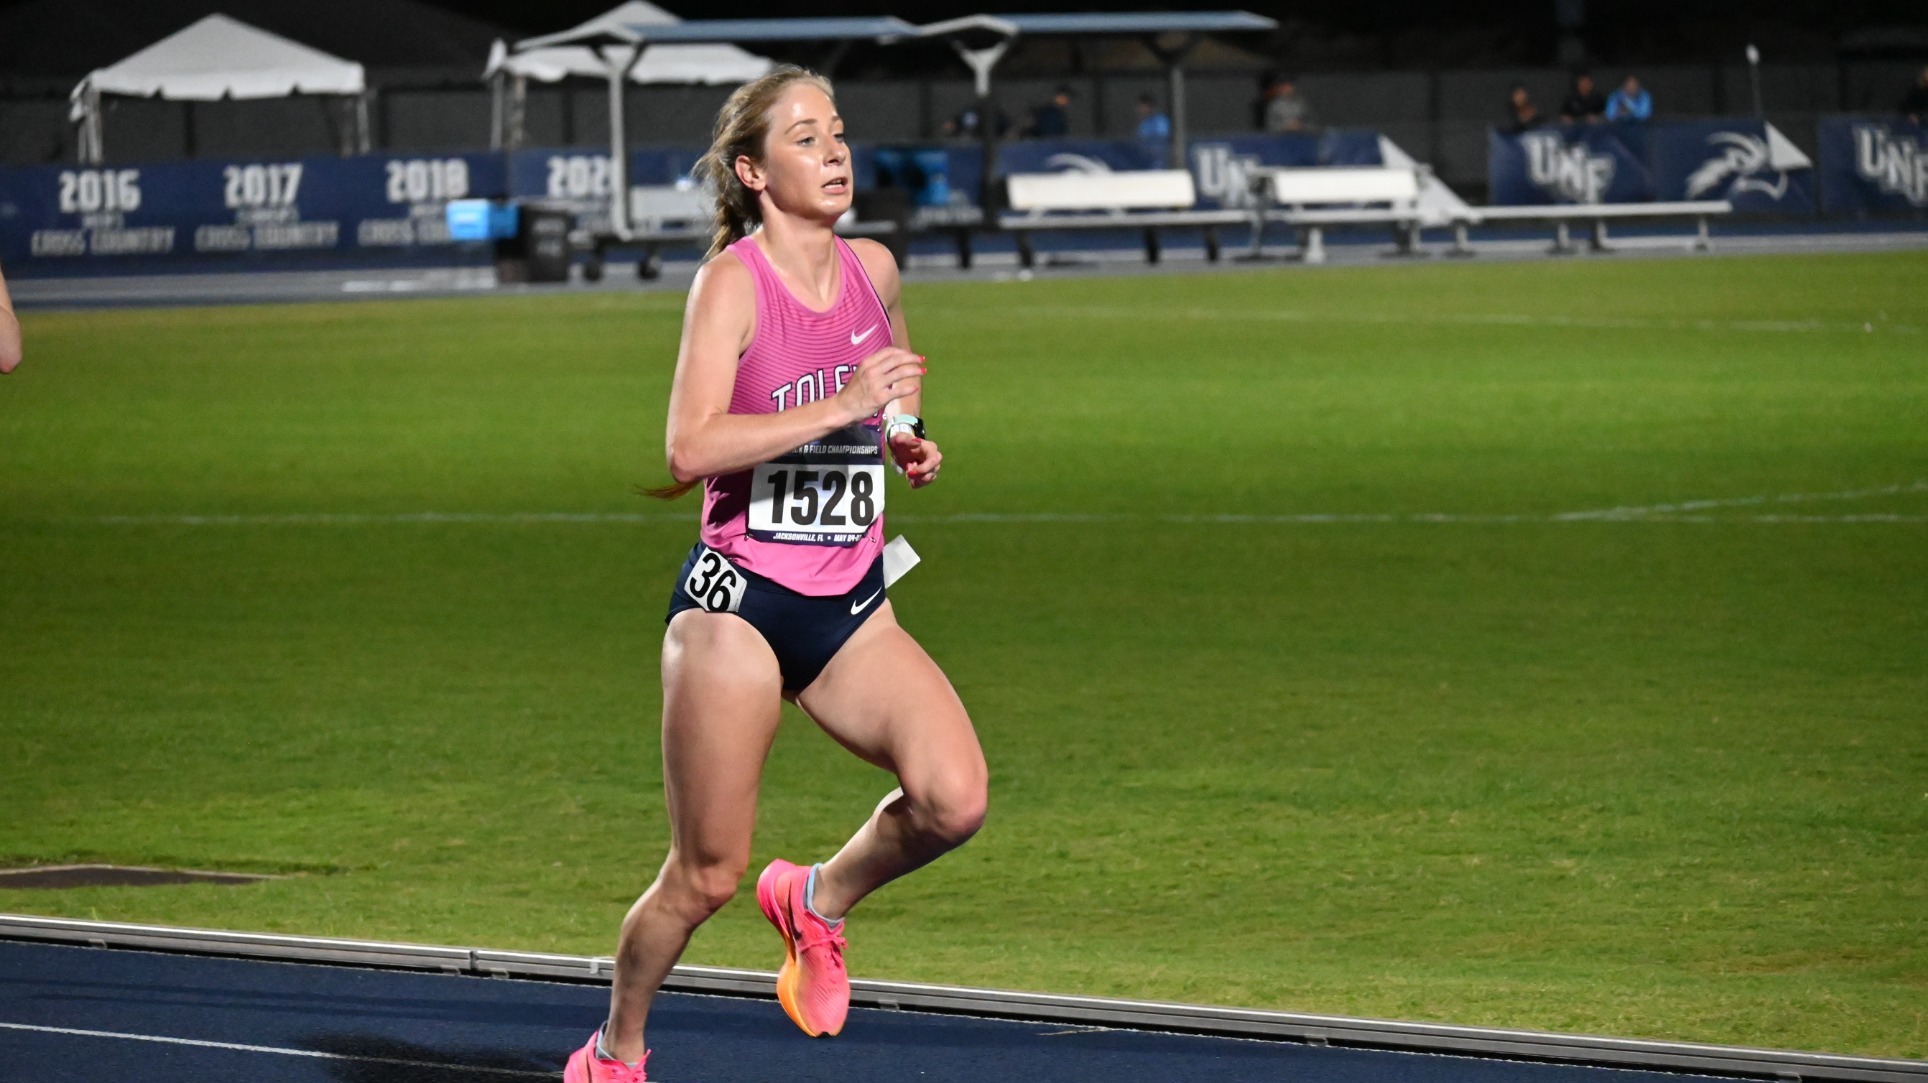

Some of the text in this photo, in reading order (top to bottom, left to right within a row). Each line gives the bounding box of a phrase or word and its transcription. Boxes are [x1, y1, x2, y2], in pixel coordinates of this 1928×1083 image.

[223, 163, 303, 208] 2017
[385, 158, 468, 203] 2018
[546, 155, 612, 198] 202
[1521, 131, 1616, 205] UNF
[59, 169, 141, 213] 2016
[809, 444, 827, 454] FIELD
[827, 444, 878, 455] CHAMPIONSHIPS
[767, 470, 874, 527] 1528
[817, 534, 824, 542] FL
[834, 534, 847, 542] MAY
[689, 552, 737, 612] 36
